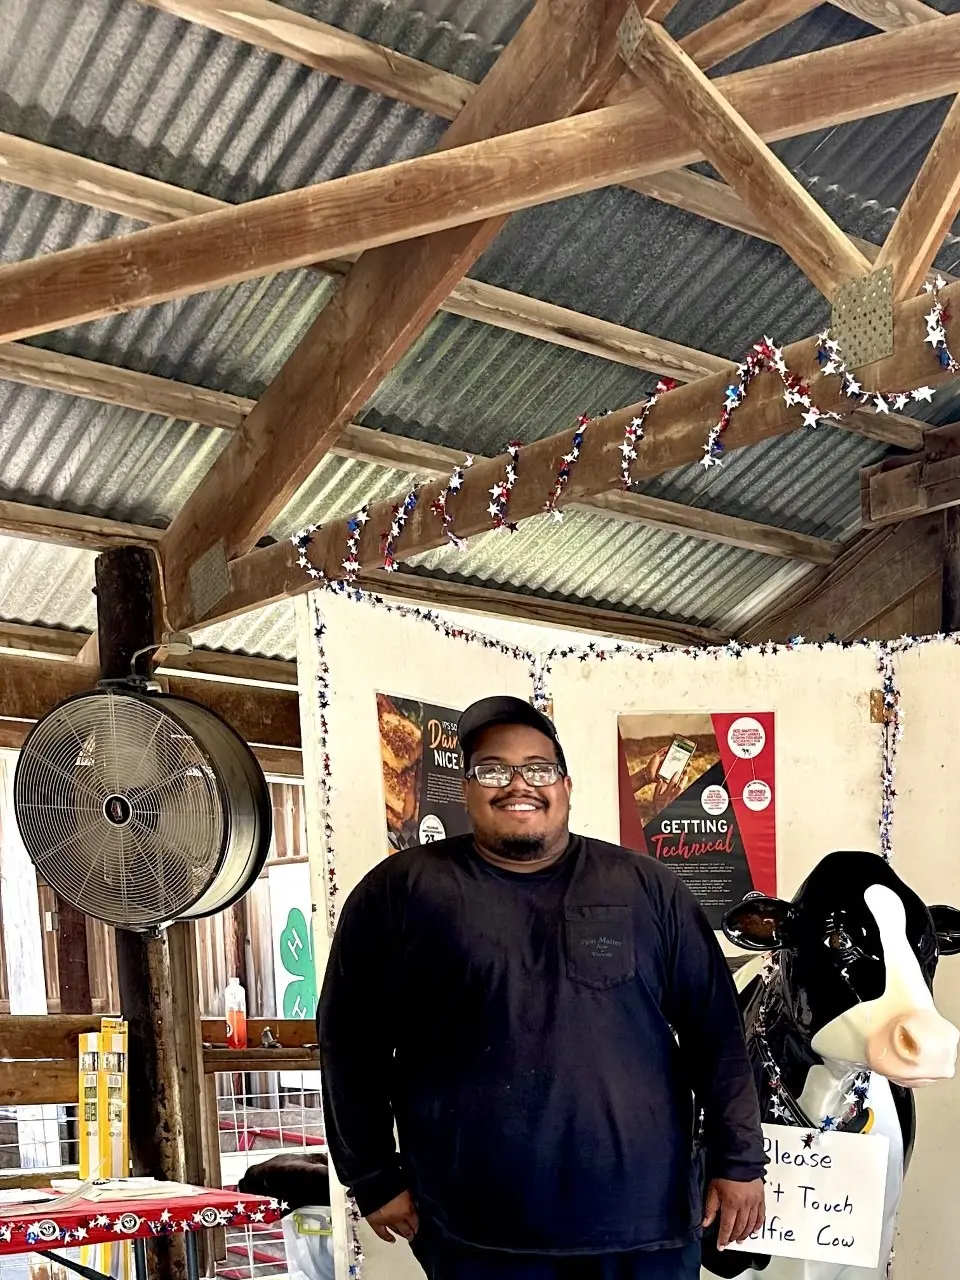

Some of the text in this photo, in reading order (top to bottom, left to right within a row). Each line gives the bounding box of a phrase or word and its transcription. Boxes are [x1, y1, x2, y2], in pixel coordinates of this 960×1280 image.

[428, 719, 460, 749] Dair
[434, 749, 459, 770] NICE
[661, 820, 728, 834] GETTING
[651, 824, 735, 860] Technical
[797, 1185, 853, 1215] Touch
[817, 1225, 855, 1248] Cow
